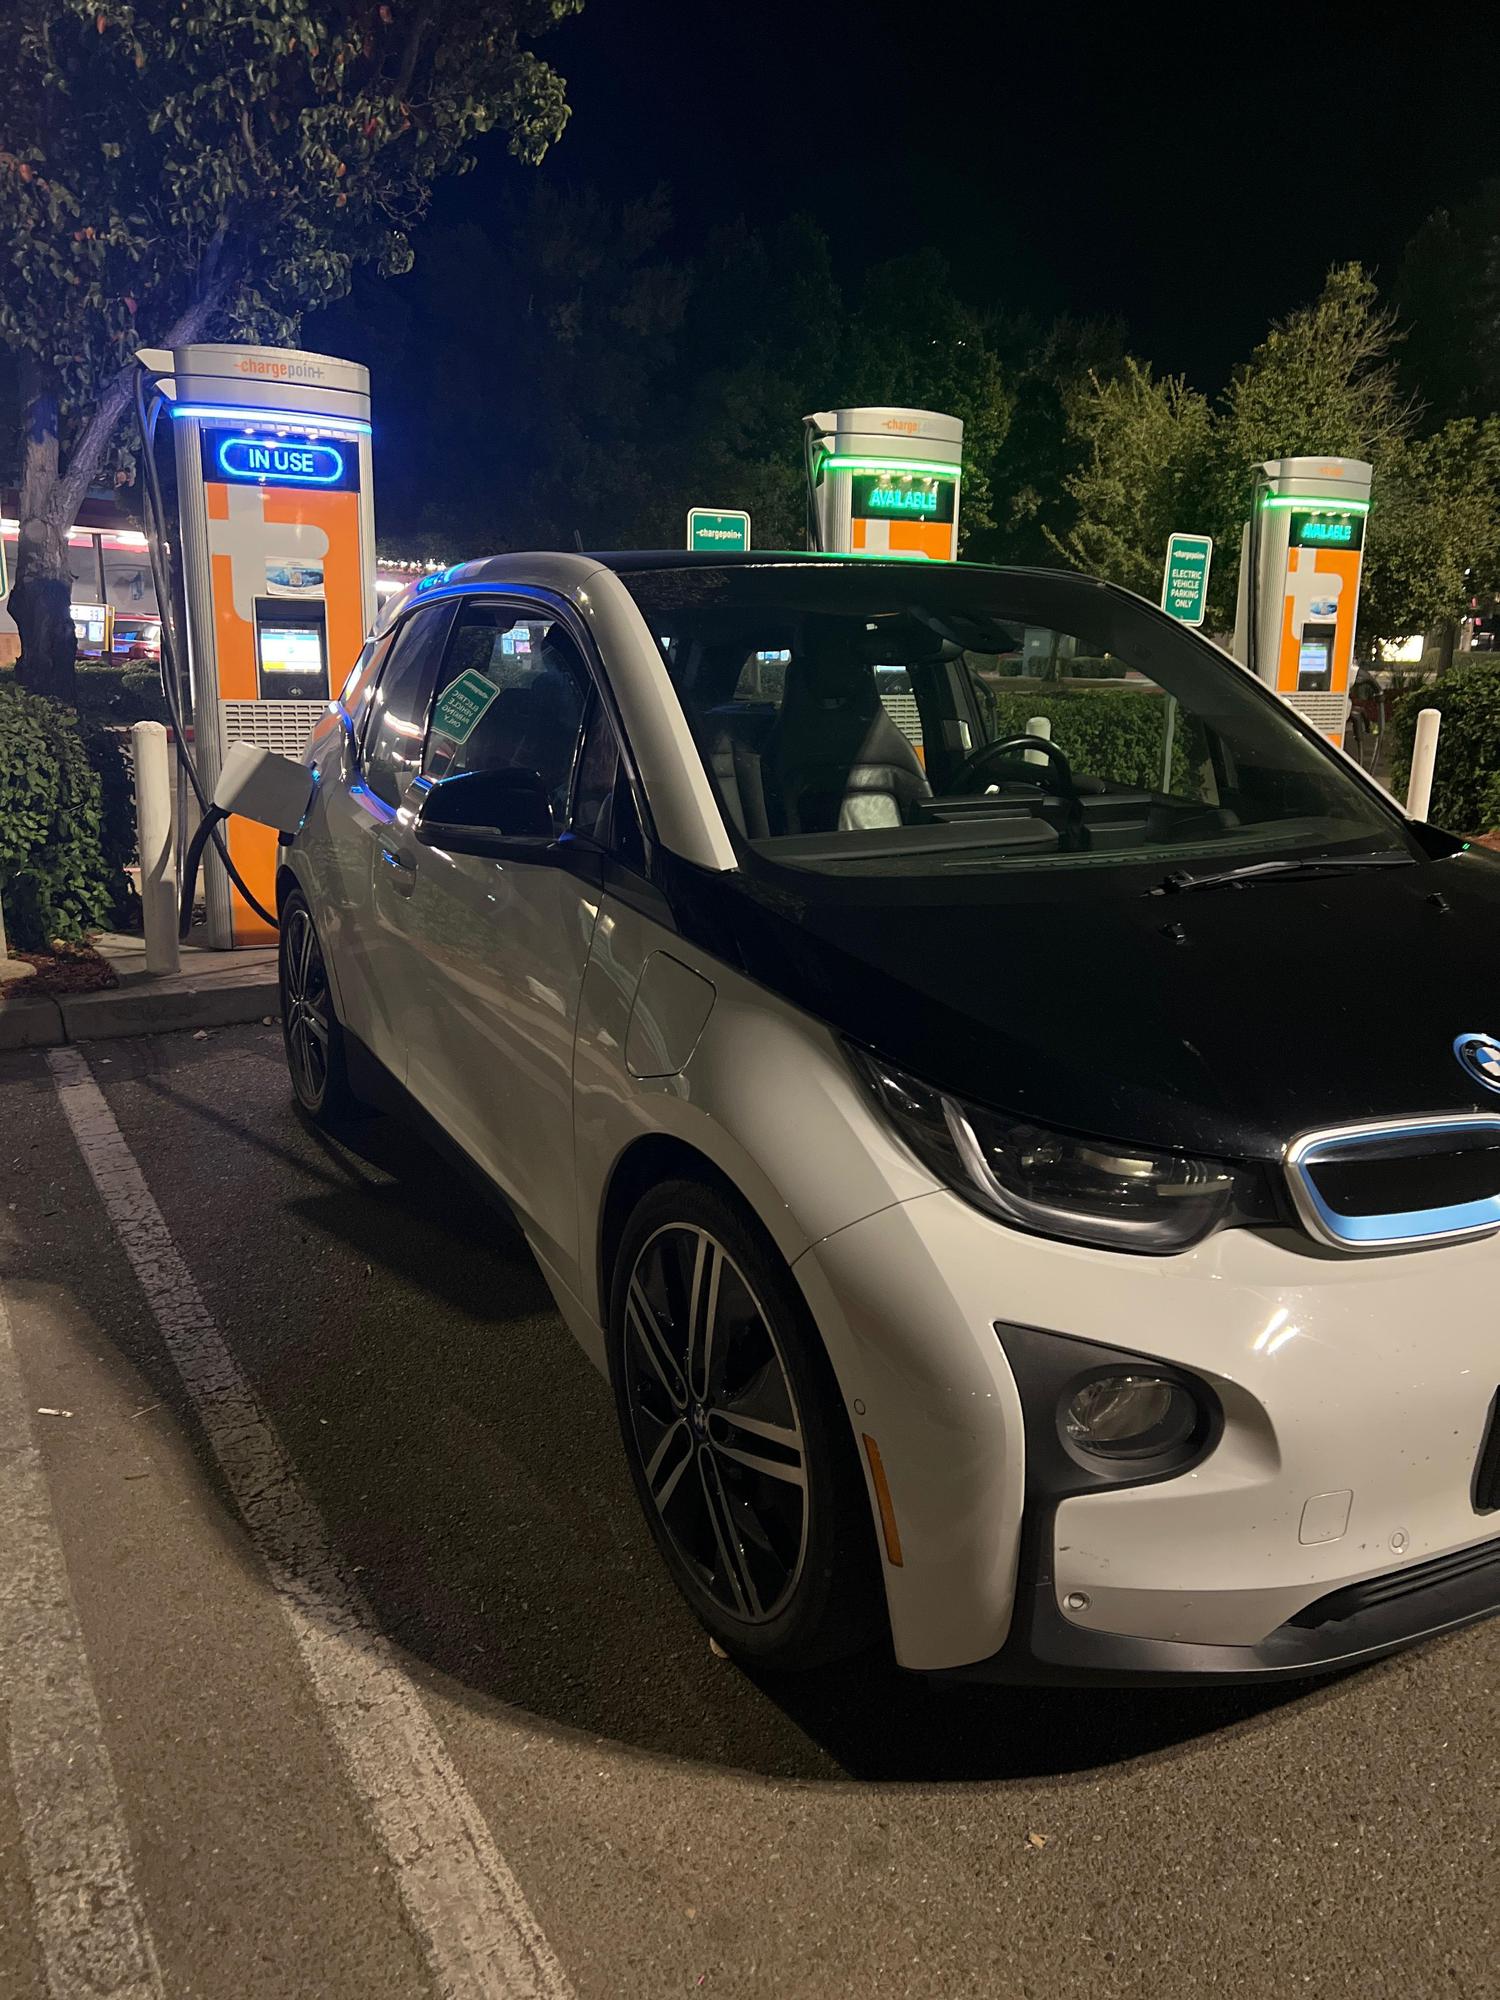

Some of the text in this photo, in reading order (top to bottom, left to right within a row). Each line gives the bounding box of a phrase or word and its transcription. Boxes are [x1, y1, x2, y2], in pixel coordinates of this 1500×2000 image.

[249, 448, 314, 473] IN USE
[868, 487, 937, 511] AVAILABLE
[1301, 523, 1352, 540] AVAILABLE
[1172, 568, 1202, 580] ELECTRIC
[1172, 579, 1200, 590] VEHICLE
[1170, 588, 1199, 600] PARKING
[1175, 598, 1193, 609] ONLY
